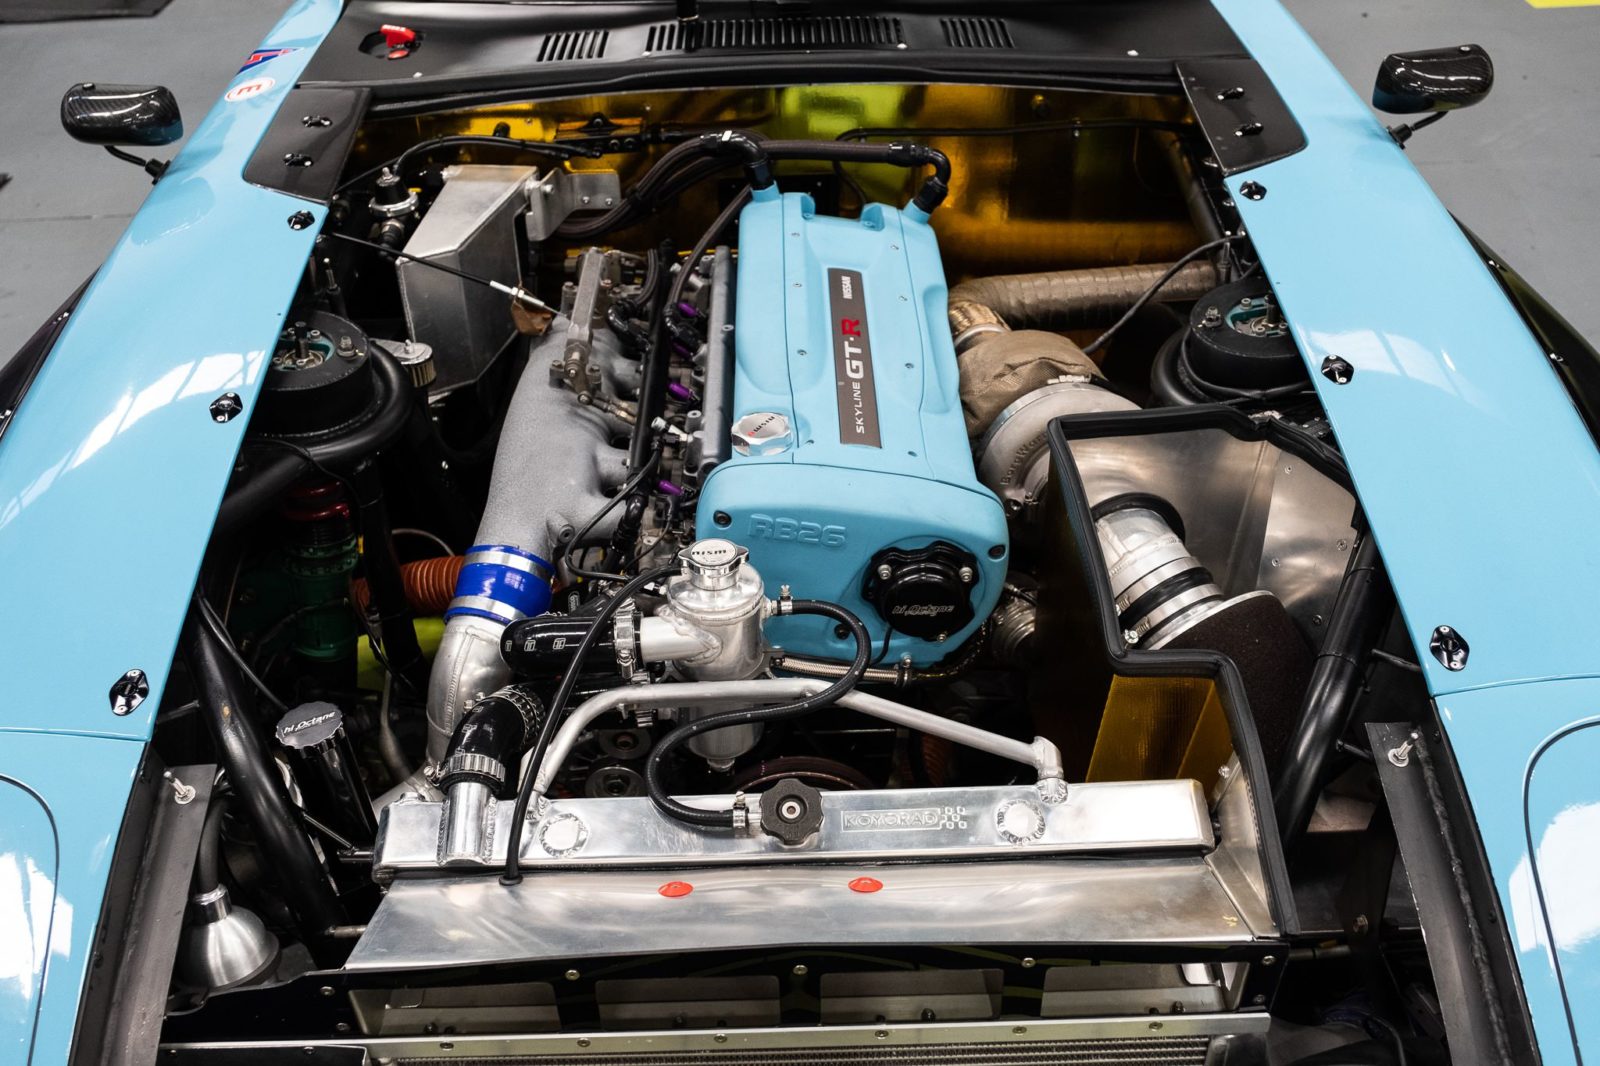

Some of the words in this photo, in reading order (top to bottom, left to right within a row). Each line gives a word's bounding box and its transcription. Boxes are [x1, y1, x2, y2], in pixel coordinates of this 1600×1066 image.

[841, 275, 853, 300] NISSAN
[852, 381, 865, 434] SKYLINE
[747, 513, 847, 547] RB26
[843, 811, 939, 828] KOYORAD
